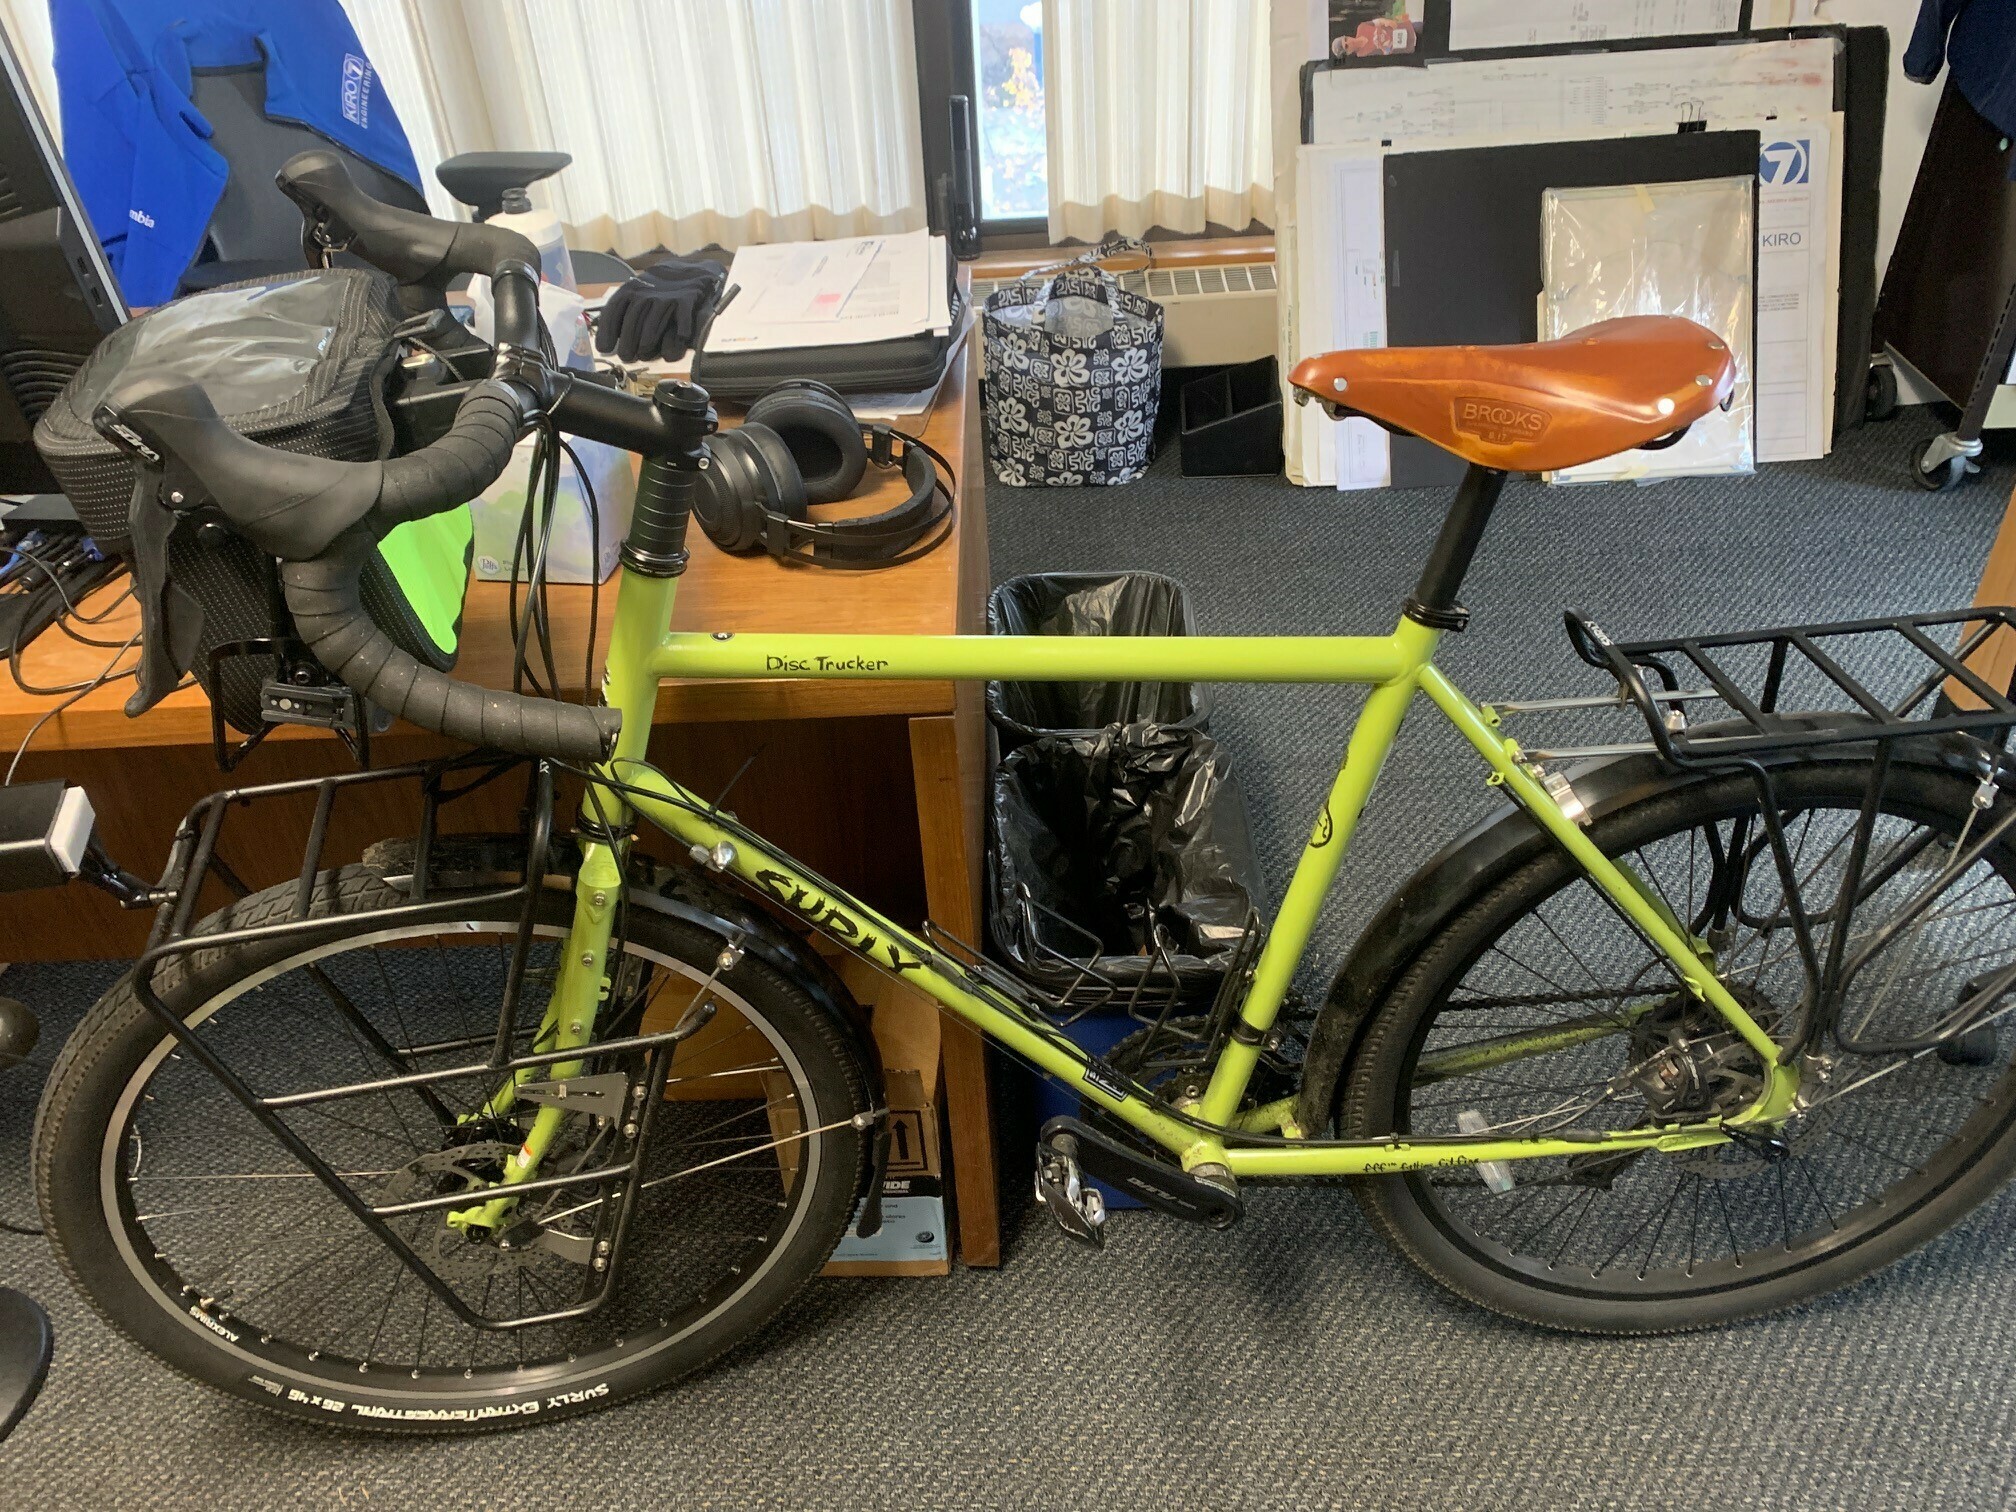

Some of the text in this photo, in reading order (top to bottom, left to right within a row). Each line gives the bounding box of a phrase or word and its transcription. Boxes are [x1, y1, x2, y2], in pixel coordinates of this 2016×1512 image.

[344, 79, 358, 122] KIRO
[360, 61, 374, 130] ENGINEERING
[129, 209, 155, 228] mbia
[1762, 232, 1802, 248] KIRO
[1463, 402, 1543, 431] BROOKS
[766, 653, 889, 672] Disc Trucker
[287, 1388, 310, 1404] 46
[321, 1398, 345, 1413] 26
[547, 1383, 610, 1409] SURLY
